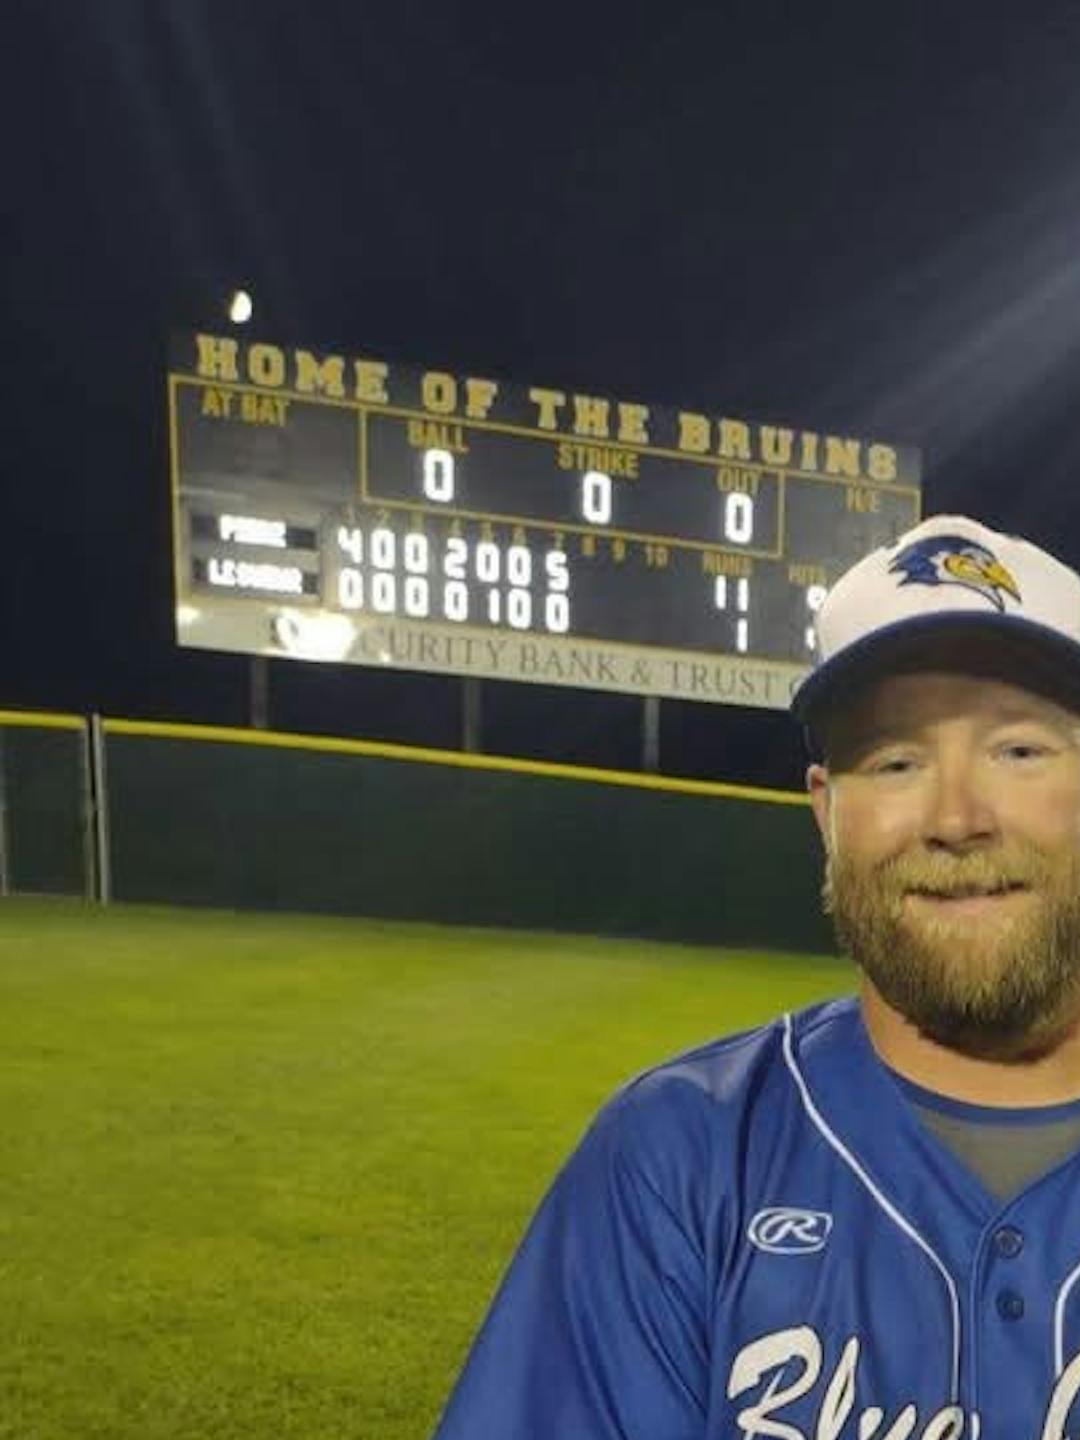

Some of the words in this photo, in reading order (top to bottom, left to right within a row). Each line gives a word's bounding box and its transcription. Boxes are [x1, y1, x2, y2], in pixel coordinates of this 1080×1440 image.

[196, 333, 389, 403] HOME
[421, 372, 498, 419] OF
[529, 387, 650, 444] THE
[678, 411, 897, 481] BRUINS
[202, 387, 233, 418] AT
[241, 393, 289, 427] BAT
[408, 417, 468, 453] BALL
[423, 448, 455, 502] 0
[558, 445, 640, 480] STRIKE
[717, 467, 761, 497] OUT
[582, 470, 613, 524] 0
[724, 491, 753, 544] 0
[714, 574, 749, 612] 11
[519, 642, 624, 685] BANK
[629, 659, 653, 686] &
[667, 658, 779, 699] TRUST
